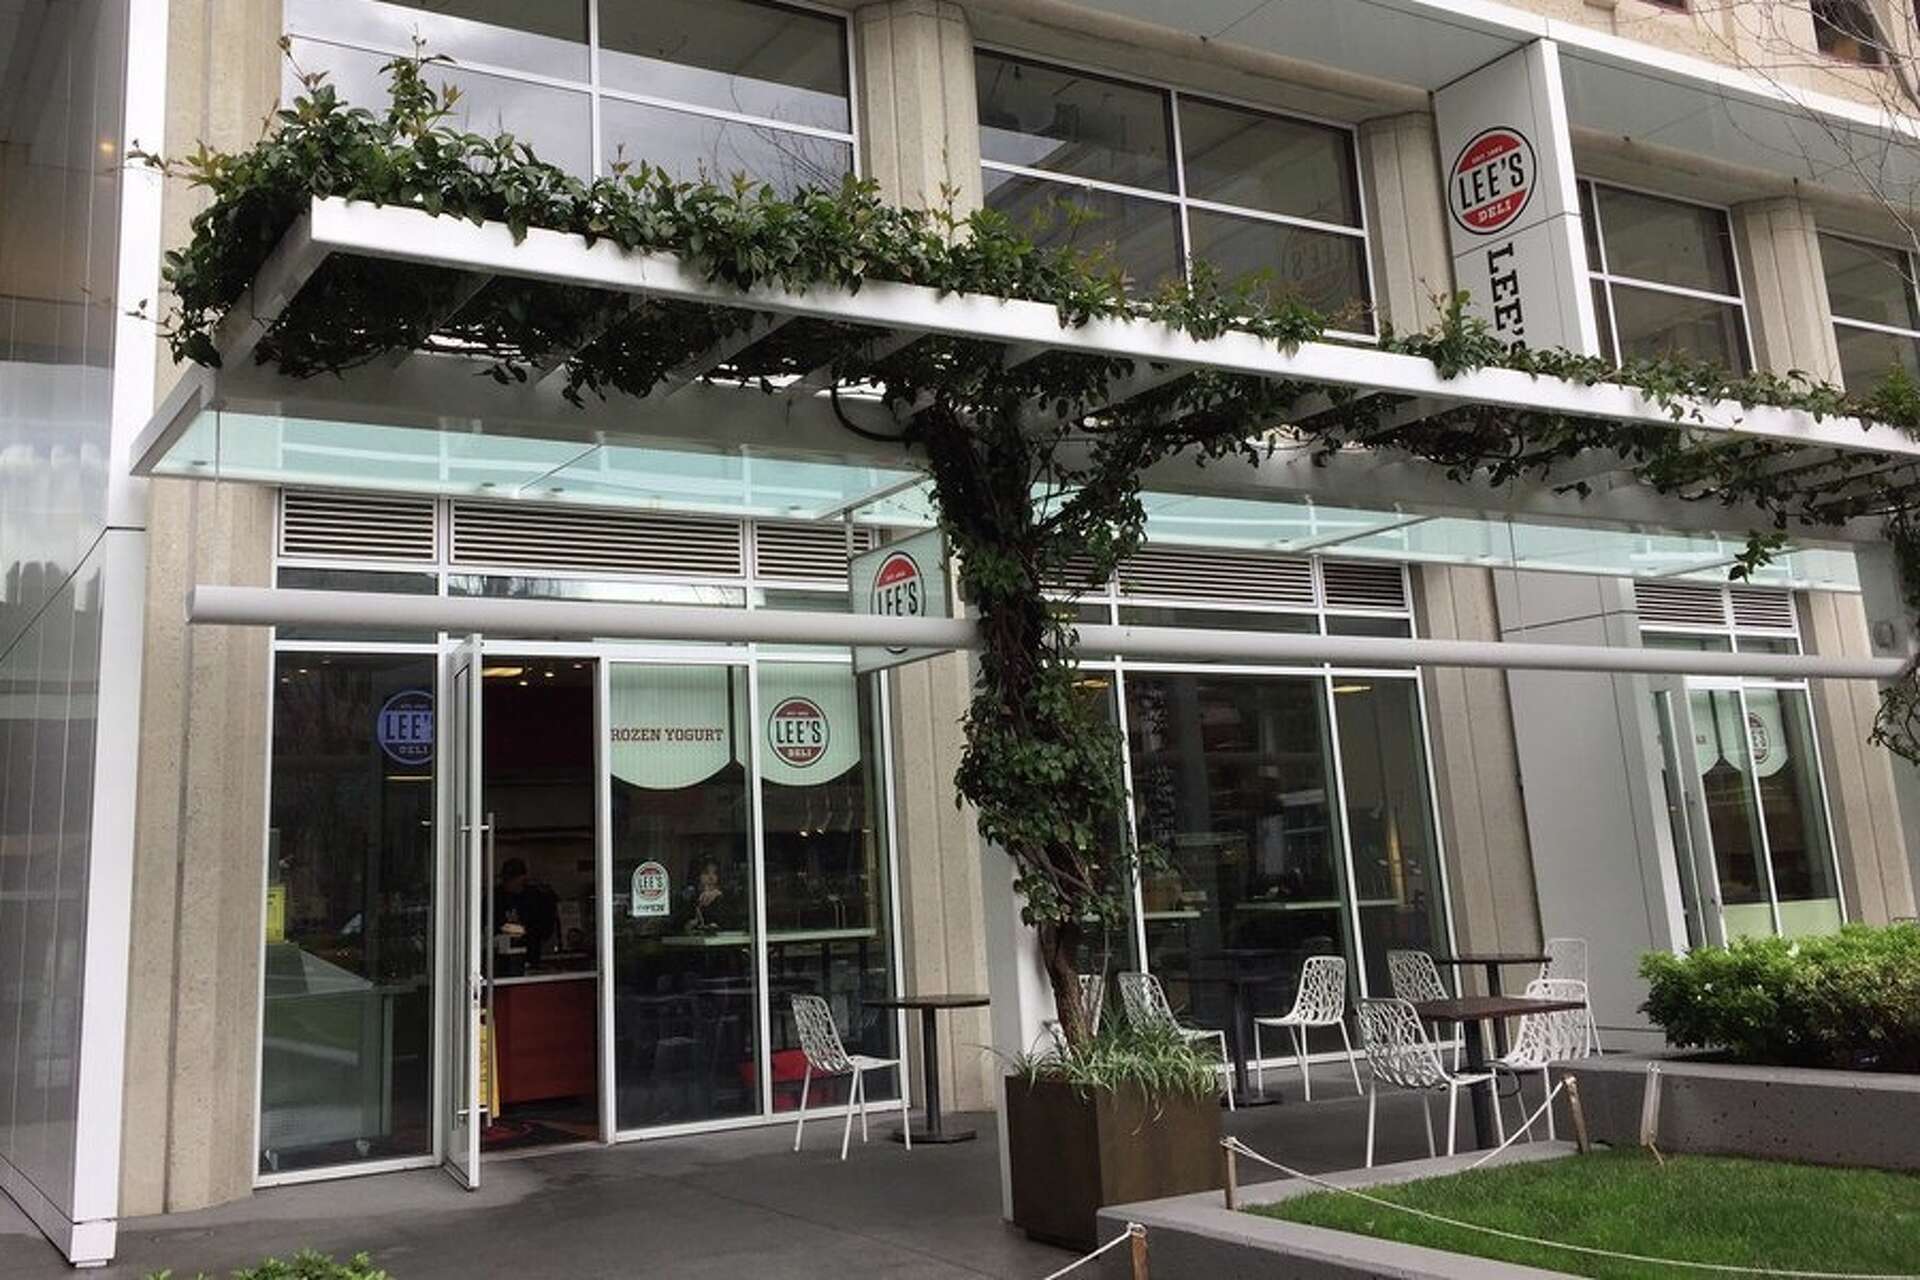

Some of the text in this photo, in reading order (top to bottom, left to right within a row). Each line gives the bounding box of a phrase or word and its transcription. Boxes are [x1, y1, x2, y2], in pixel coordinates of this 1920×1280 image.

[1459, 152, 1525, 210] LEE'S
[1477, 199, 1512, 224] DELI
[385, 714, 433, 740] LEE'
[610, 728, 724, 741] ROZEN YOGURT
[776, 720, 822, 744] LEE'S
